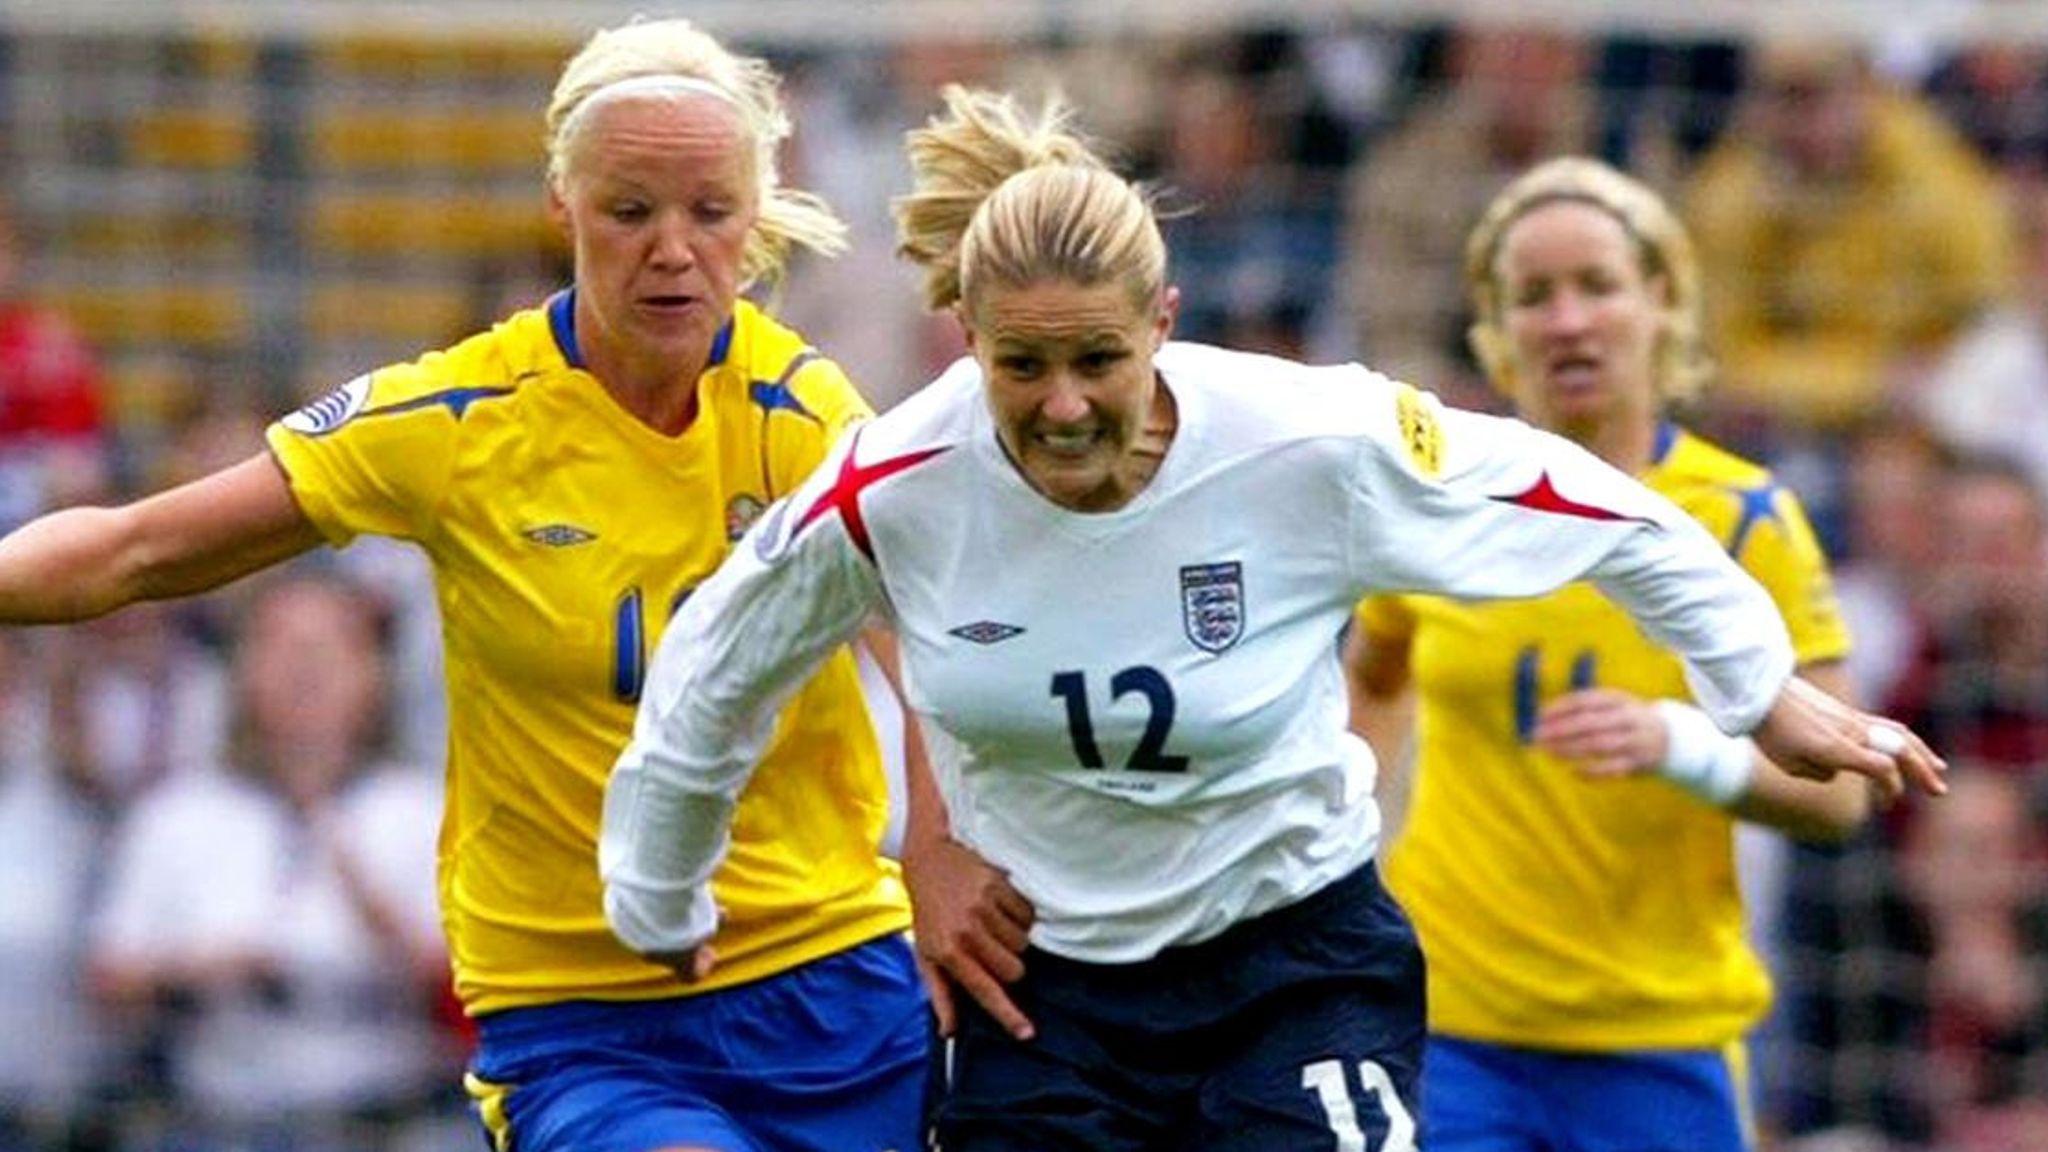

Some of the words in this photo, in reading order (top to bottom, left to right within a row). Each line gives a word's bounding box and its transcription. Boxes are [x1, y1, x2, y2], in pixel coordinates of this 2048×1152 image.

[613, 585, 697, 702] 1
[1051, 665, 1190, 772] 12
[1302, 1059, 1419, 1152] 12
